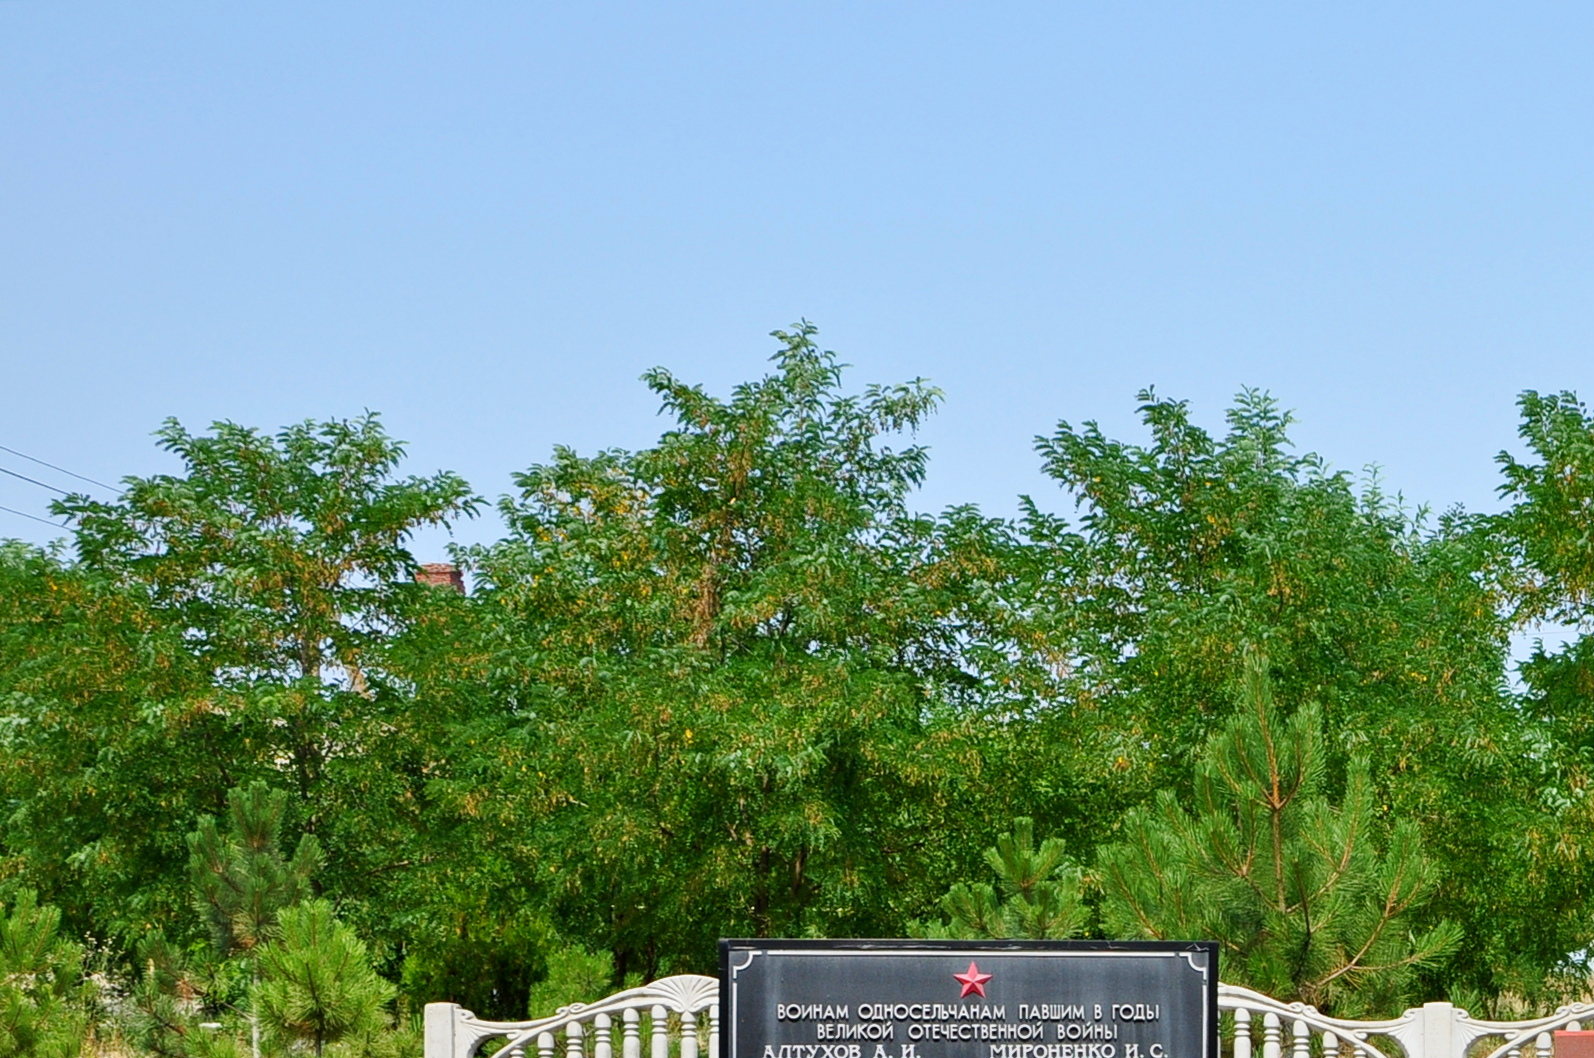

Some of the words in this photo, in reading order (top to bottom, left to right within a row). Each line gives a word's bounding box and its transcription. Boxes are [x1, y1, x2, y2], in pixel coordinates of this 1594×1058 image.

[774, 1003, 850, 1021] ВОИНАМ
[857, 1003, 1006, 1021] ОДНОСЕЛЬЧАНАМ
[1018, 1003, 1086, 1020] ПАВШИМ
[1093, 1003, 1103, 1020] В
[1111, 1003, 1160, 1021] ГОДЫ
[816, 1021, 894, 1040] ВЕЛИКОЙ
[907, 1021, 1044, 1040] ОТЕЧЕСТВЕННОЙ
[1056, 1021, 1118, 1040] ВОЙНЫ
